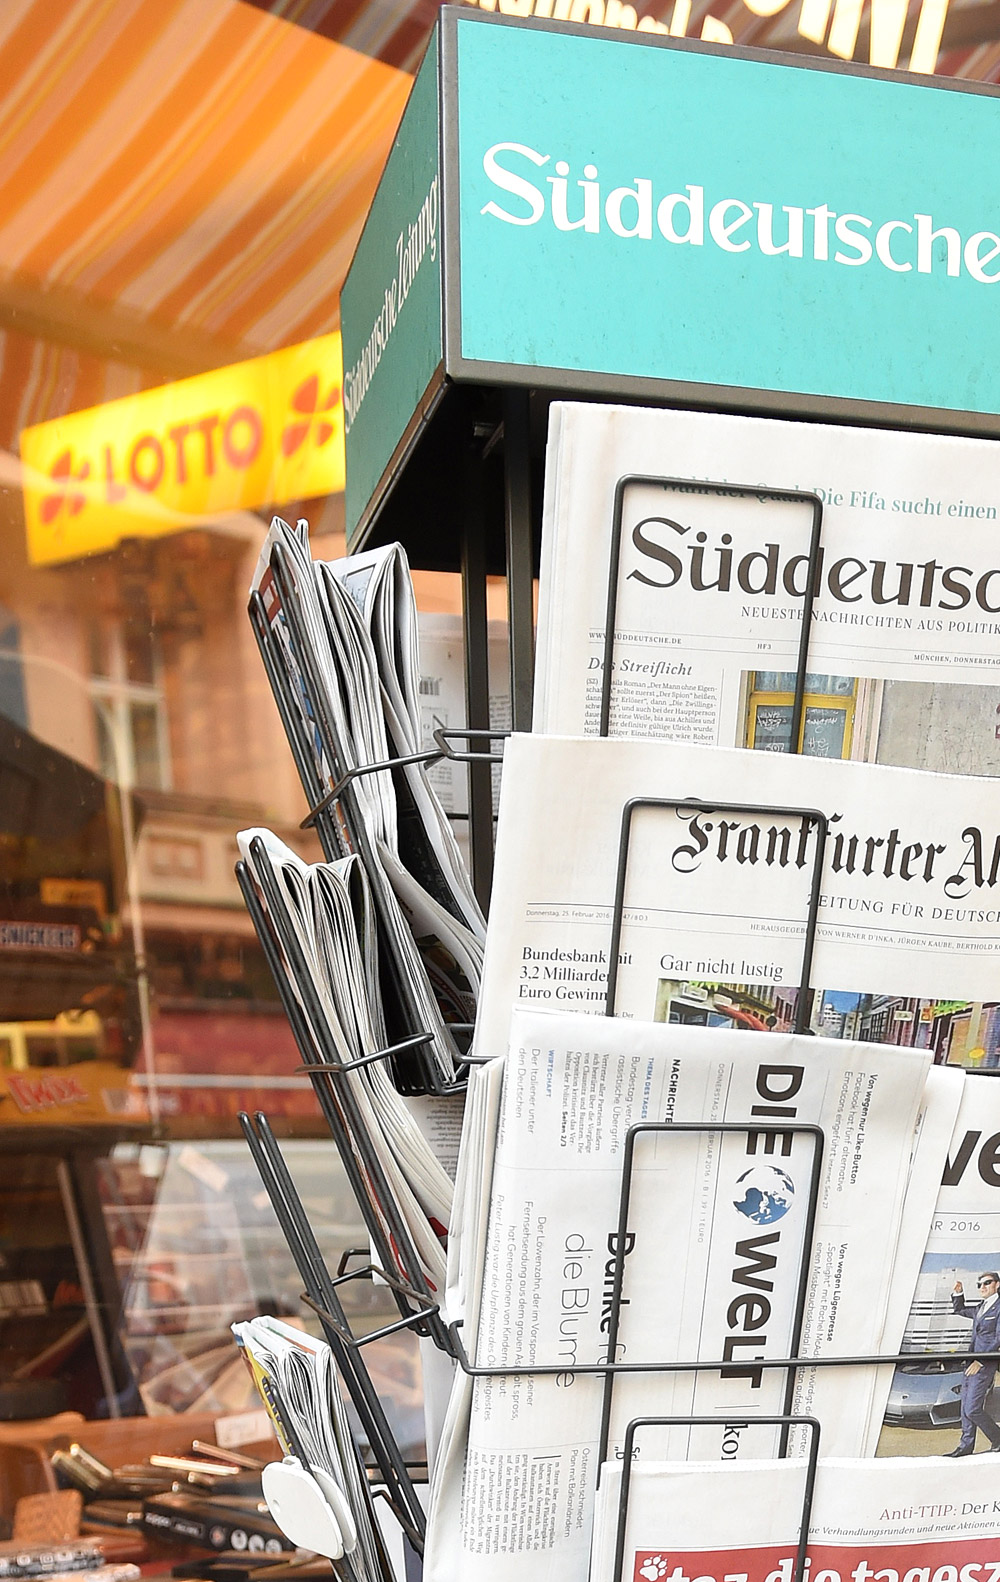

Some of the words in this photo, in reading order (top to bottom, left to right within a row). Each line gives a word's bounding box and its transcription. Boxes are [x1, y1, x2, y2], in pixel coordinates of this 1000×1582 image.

[344, 275, 398, 434] Süddeutsche
[396, 174, 440, 311] Zeitung
[102, 405, 265, 503] LOTTO
[814, 487, 843, 506] Die
[849, 489, 887, 511] Fifa
[891, 496, 943, 517] sucht
[948, 501, 998, 520] einen
[740, 605, 804, 621] NEUESTE
[809, 610, 914, 629] NACHRICHTEN
[917, 618, 944, 632] AUS
[587, 655, 616, 672] Ds
[620, 658, 693, 677] Streiflicht
[806, 892, 884, 914] ZEITUNG
[890, 900, 924, 918] FÜR
[521, 946, 608, 964] Bundesbank
[660, 954, 693, 974] Gar
[695, 956, 737, 976] nicht
[740, 958, 785, 981] lustig
[518, 965, 540, 980] 3,2
[517, 983, 552, 999] Euro
[664, 1058, 680, 1126] NACHRICHTE
[868, 1073, 879, 1090] Von
[746, 1064, 805, 1157] DIE
[861, 1090, 873, 1117] wegen
[859, 1117, 868, 1131] nur
[849, 1132, 866, 1185] Like-Button
[950, 1219, 981, 1232] 2016
[561, 1234, 592, 1280] die
[840, 1242, 849, 1260] Von
[834, 1260, 844, 1289] wegen
[826, 1290, 842, 1342] Lügenpresse
[555, 1289, 590, 1388] Blume
[879, 1503, 958, 1522] Anti-TTIP:
[960, 1501, 989, 1516] Der
